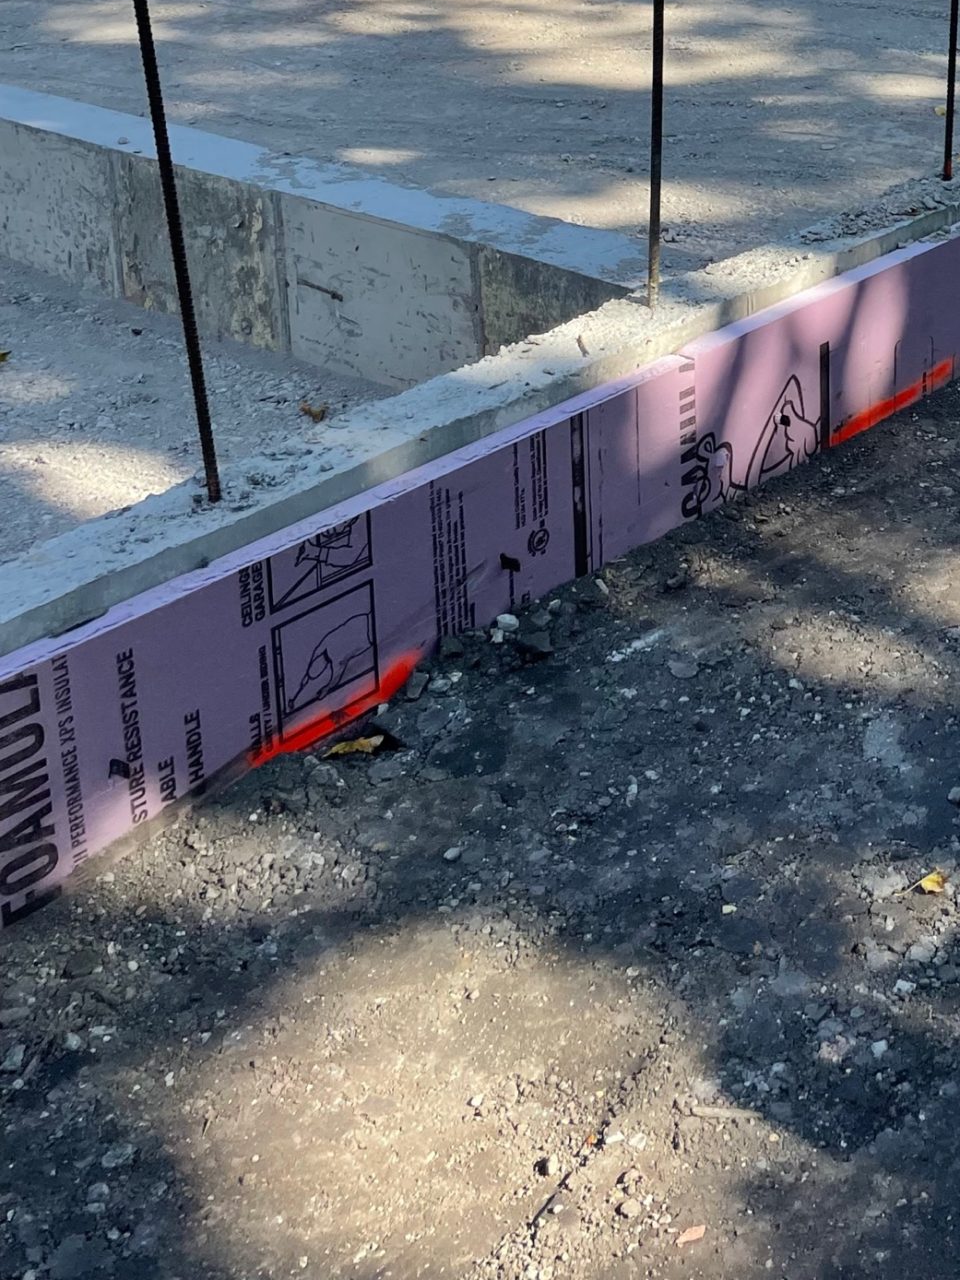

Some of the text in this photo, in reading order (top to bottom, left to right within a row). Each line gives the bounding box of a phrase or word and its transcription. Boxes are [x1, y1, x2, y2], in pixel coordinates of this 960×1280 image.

[57, 715, 76, 747] XPS
[116, 647, 144, 763] RESISTANCE
[157, 754, 178, 804] ABLE
[184, 708, 206, 785] HANDLE
[61, 745, 87, 849] PERFORMANCE
